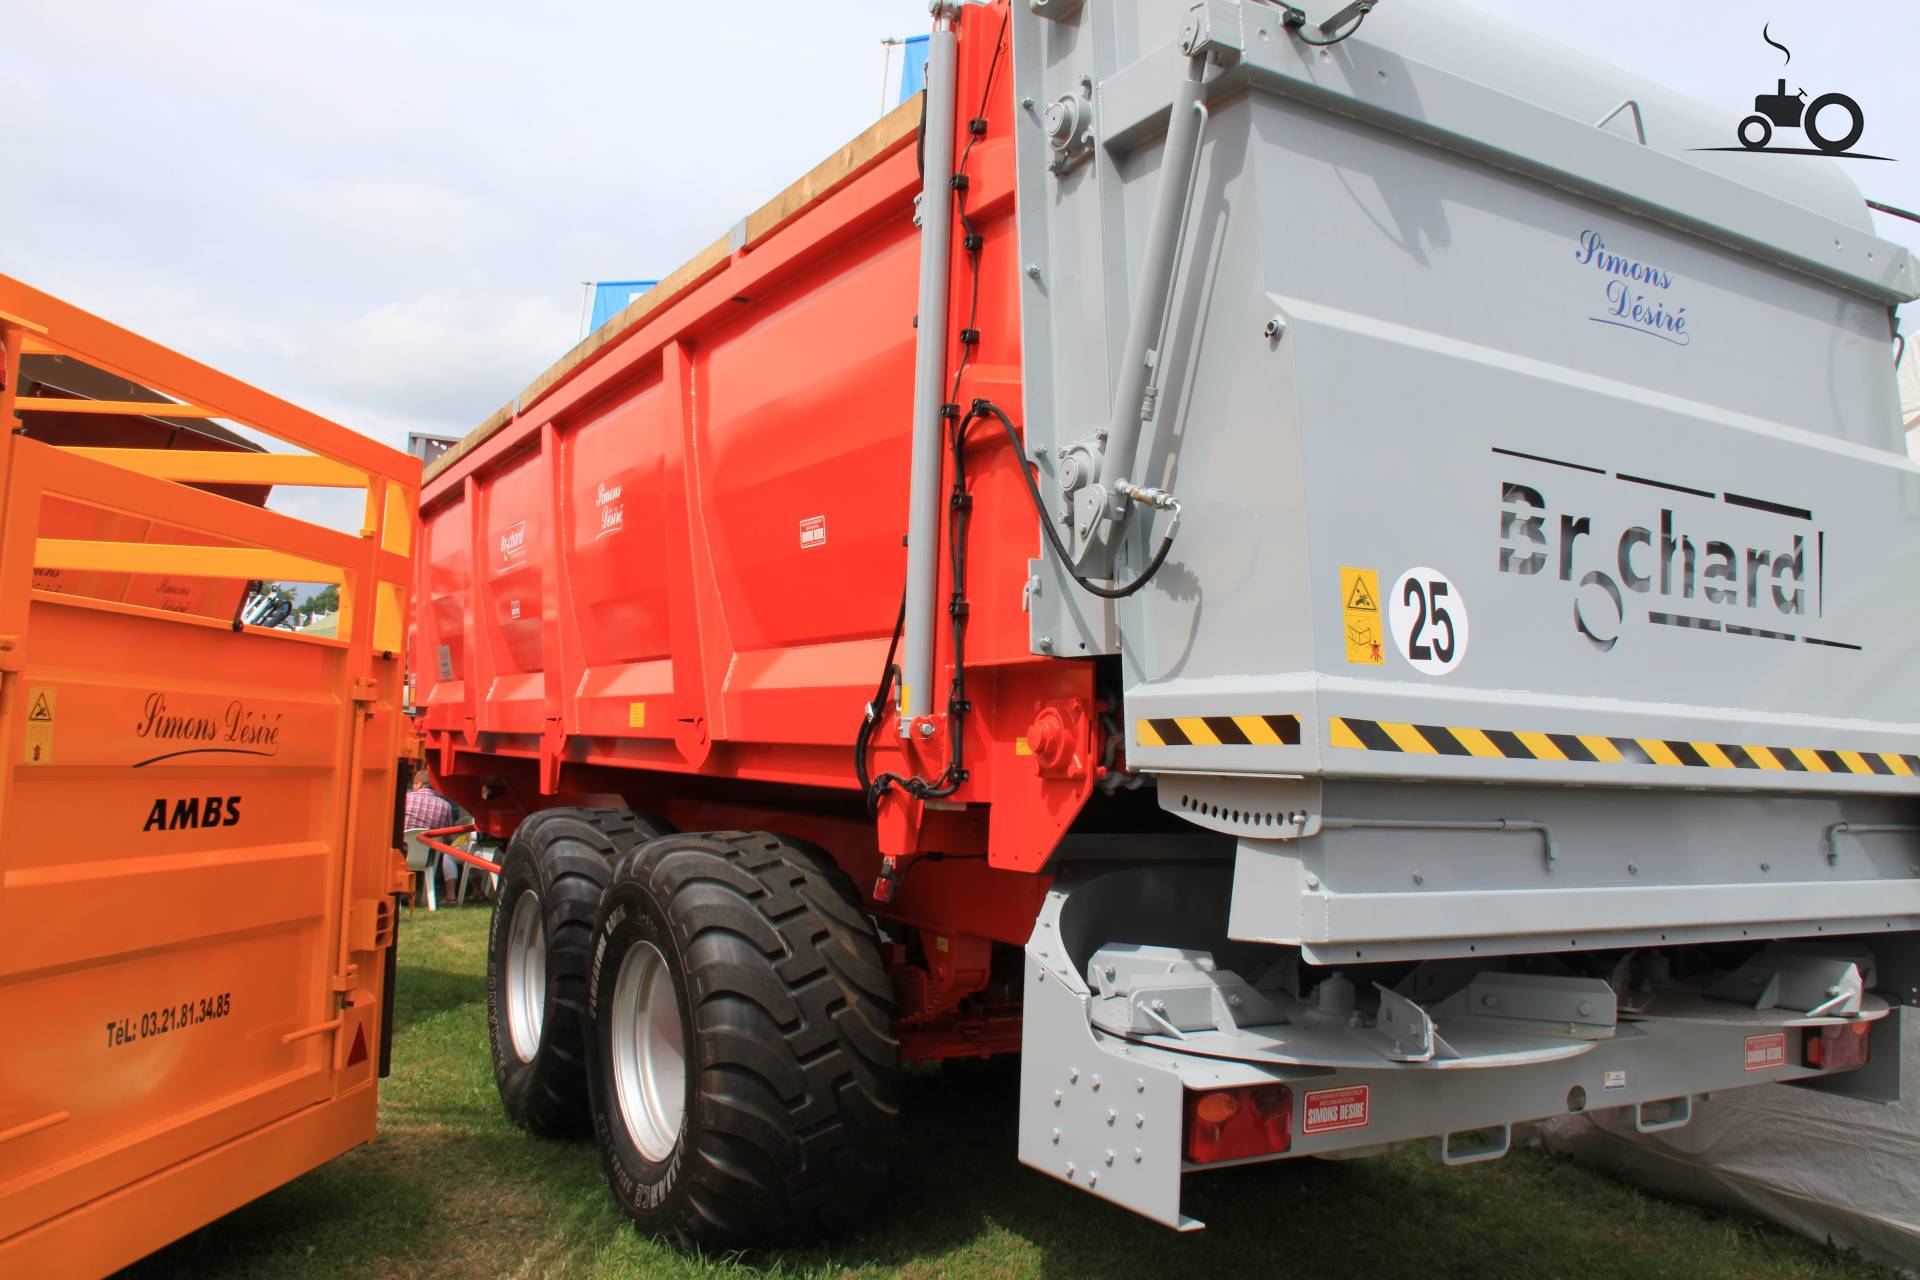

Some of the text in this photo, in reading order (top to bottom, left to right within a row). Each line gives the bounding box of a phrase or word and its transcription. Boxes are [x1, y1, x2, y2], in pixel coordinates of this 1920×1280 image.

[1575, 230, 1673, 290] Simons
[1606, 280, 1687, 335] Désiré
[596, 482, 622, 507] Simons
[1499, 482, 1805, 653] Brochard
[1403, 577, 1455, 664] 25
[136, 692, 283, 746] Simons Désiré
[142, 796, 242, 832] AMBS
[141, 992, 230, 1040] 03.21.81.34.85
[1307, 1105, 1339, 1125] SIMONS
[1339, 1102, 1365, 1121] DESIRE
